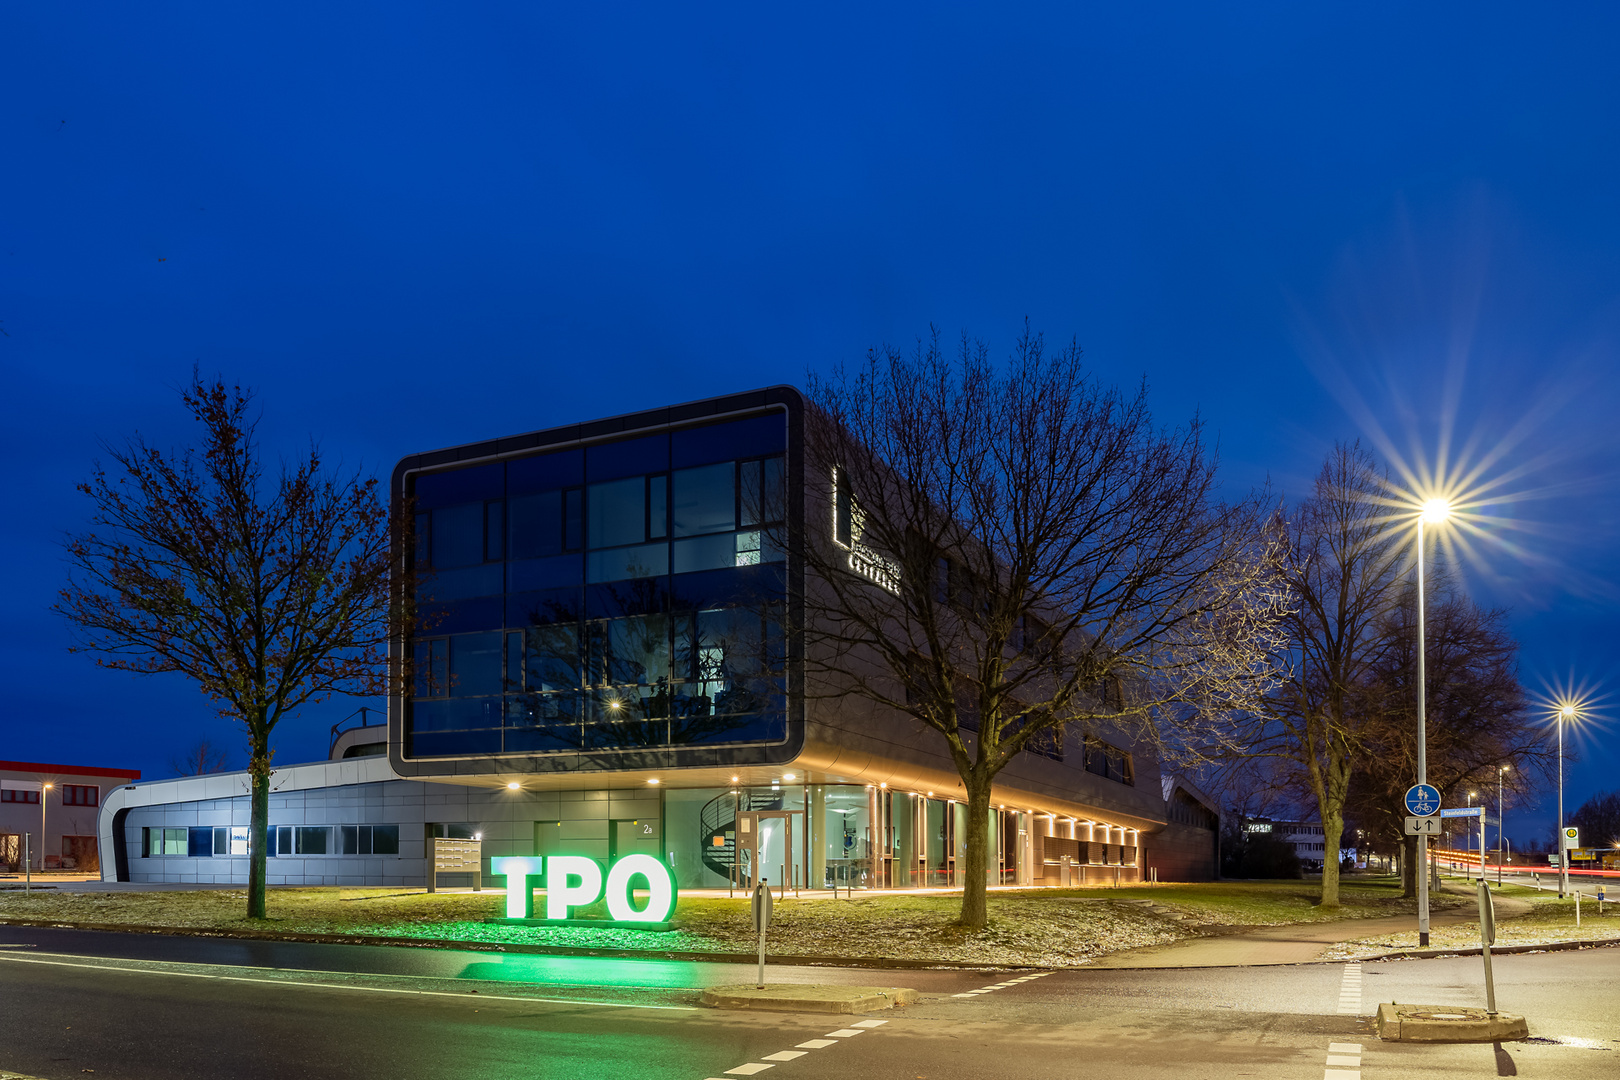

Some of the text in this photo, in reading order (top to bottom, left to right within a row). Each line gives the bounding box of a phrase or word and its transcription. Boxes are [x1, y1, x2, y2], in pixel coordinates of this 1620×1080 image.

[1443, 809, 1478, 817] Steinfeldstraße
[643, 824, 653, 834] 2a
[491, 854, 675, 922] TPO
